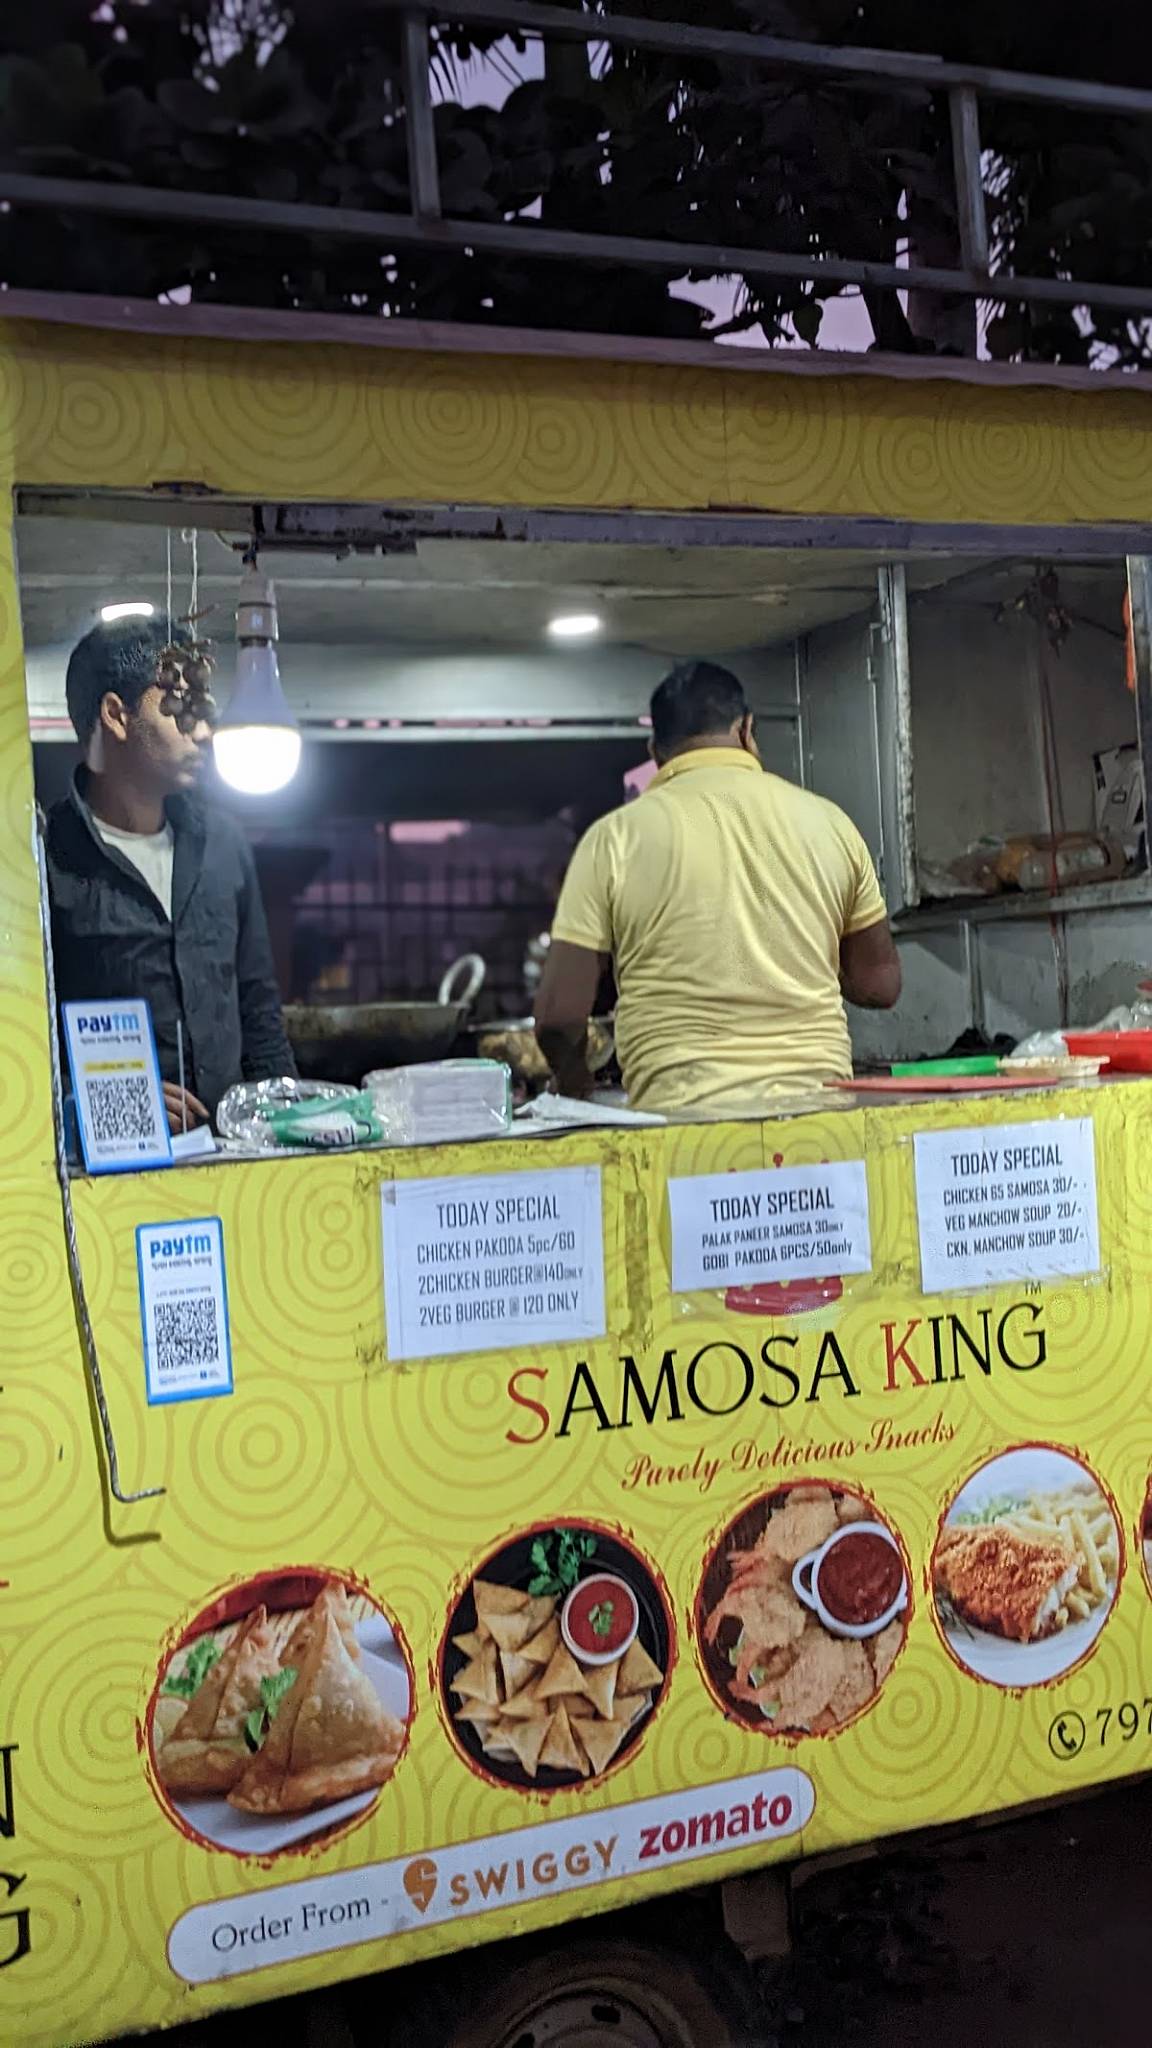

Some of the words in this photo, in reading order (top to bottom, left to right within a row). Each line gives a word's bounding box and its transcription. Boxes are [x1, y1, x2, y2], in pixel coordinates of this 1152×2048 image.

[951, 1151, 999, 1177] TODAY
[1003, 1143, 1063, 1171] SPECIAL
[709, 1193, 762, 1223] TODAY
[768, 1186, 835, 1215] SPECIAL
[943, 1185, 988, 1207] CHICKEN
[991, 1184, 1005, 1201] 65
[1007, 1180, 1050, 1199] SAMOSA
[436, 1201, 490, 1229] TODAY
[495, 1195, 560, 1224] SPECIAL
[945, 1213, 966, 1232] VEG
[969, 1209, 1021, 1230] MANCHOW
[1023, 1204, 1051, 1225] SOUP
[416, 1240, 471, 1265] CHICKEN
[475, 1235, 524, 1259] PAKODA
[528, 1230, 575, 1257] 5pc/60
[702, 1230, 733, 1249] PALAK
[734, 1225, 770, 1245] PANEER
[773, 1222, 813, 1241] SAMOSA
[974, 1235, 1025, 1255] MANCHOW
[1029, 1230, 1057, 1249] SOUP
[703, 1253, 729, 1272] GOBI
[735, 1247, 779, 1267] PAKODA
[418, 1270, 480, 1296] 2CHICKEN
[419, 1302, 452, 1327] 2VEG
[455, 1298, 506, 1323] BURGER
[523, 1294, 544, 1315] 120
[547, 1290, 579, 1312] ONLY
[505, 1330, 860, 1444] SAMOSA
[880, 1302, 1047, 1392] KING
[621, 1447, 722, 1493] Purely
[731, 1435, 857, 1471] Delicious
[864, 1412, 957, 1453] Snacks
[211, 1914, 294, 1953] Order
[300, 1895, 371, 1932] From
[448, 1834, 619, 1907] SWIGGY
[638, 1791, 793, 1861] zomato
